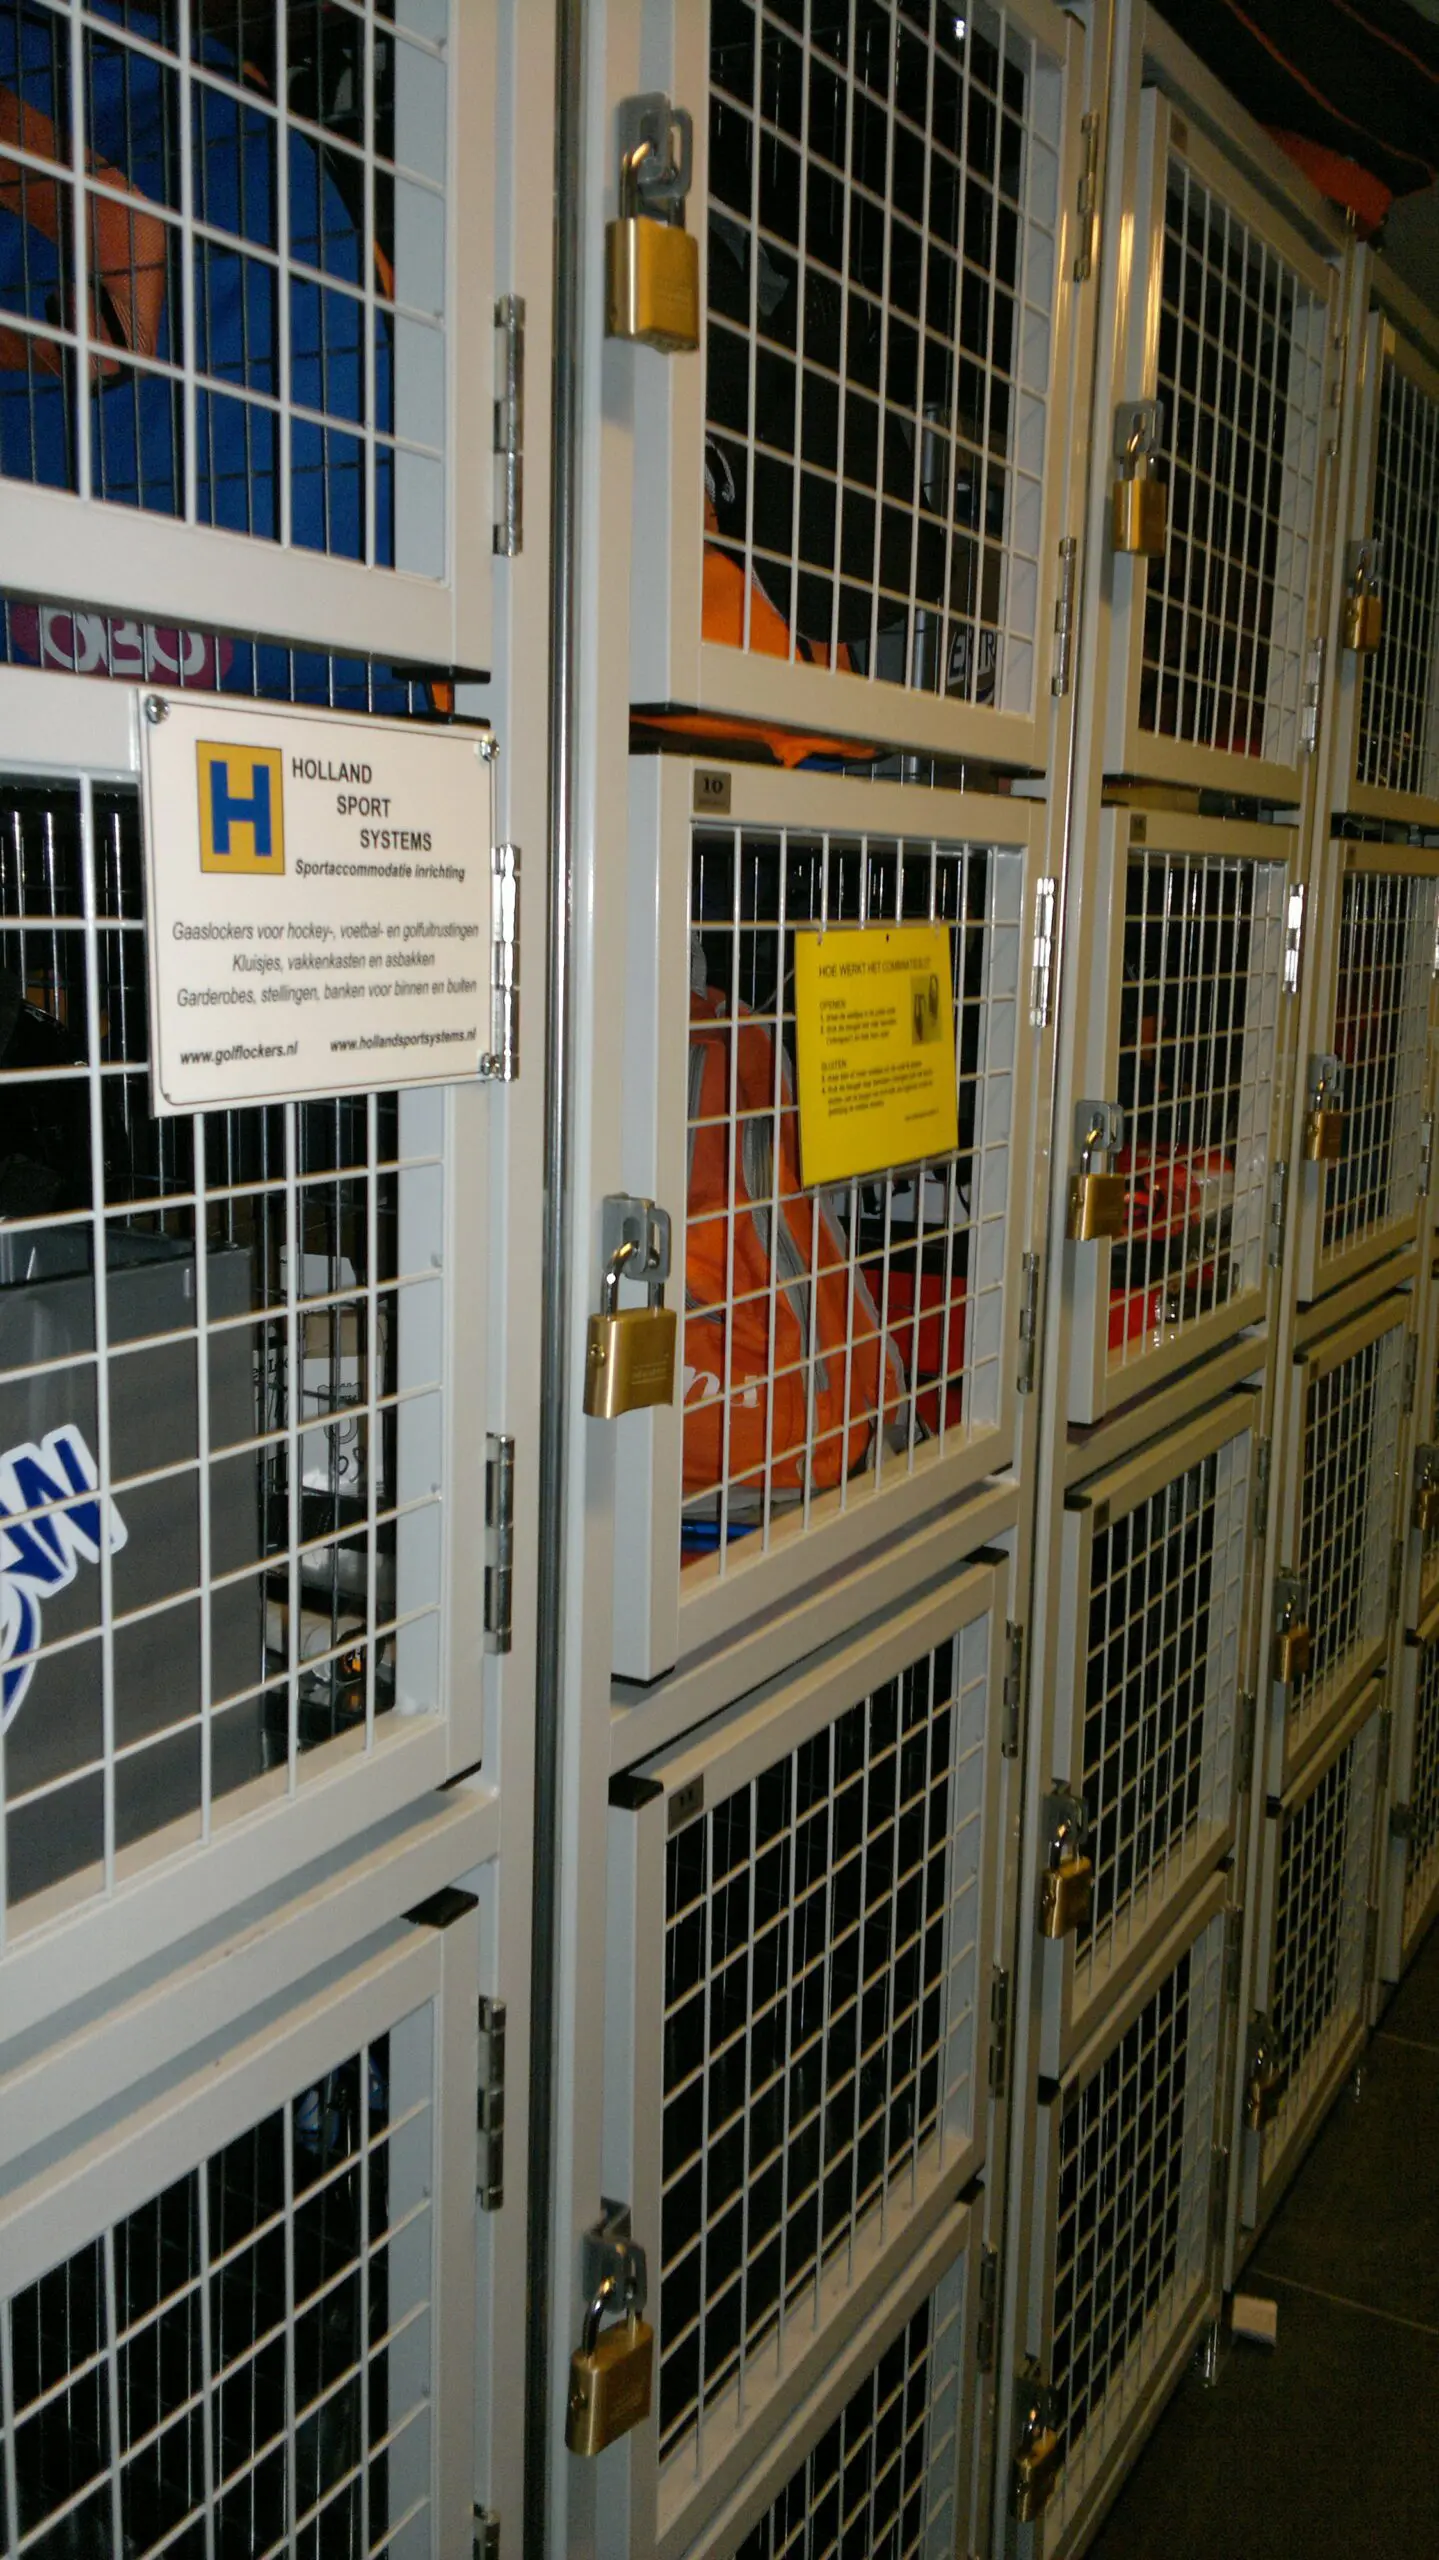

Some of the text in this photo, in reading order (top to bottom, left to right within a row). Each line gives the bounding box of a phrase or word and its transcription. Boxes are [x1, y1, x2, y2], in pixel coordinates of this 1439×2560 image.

[292, 757, 373, 784] HOLLAND
[703, 776, 724, 795] 10
[209, 759, 272, 857] H
[336, 795, 392, 817] SPORT
[360, 829, 432, 851] SYSTEMS
[295, 859, 465, 883] Sportaccommodatie inrichting
[172, 920, 479, 943] Gaaslockers voor hockey-, voetbal- en golfuitrustingen
[232, 951, 436, 975] Kluisjes, vakkenkasten en asbakken
[819, 963, 837, 978] HOE
[177, 977, 477, 1007] Garderobes, stellingen, banken voor binnen en buiten
[180, 1028, 477, 1066] www.golflockers.nl www.hollandsportsystems.nl
